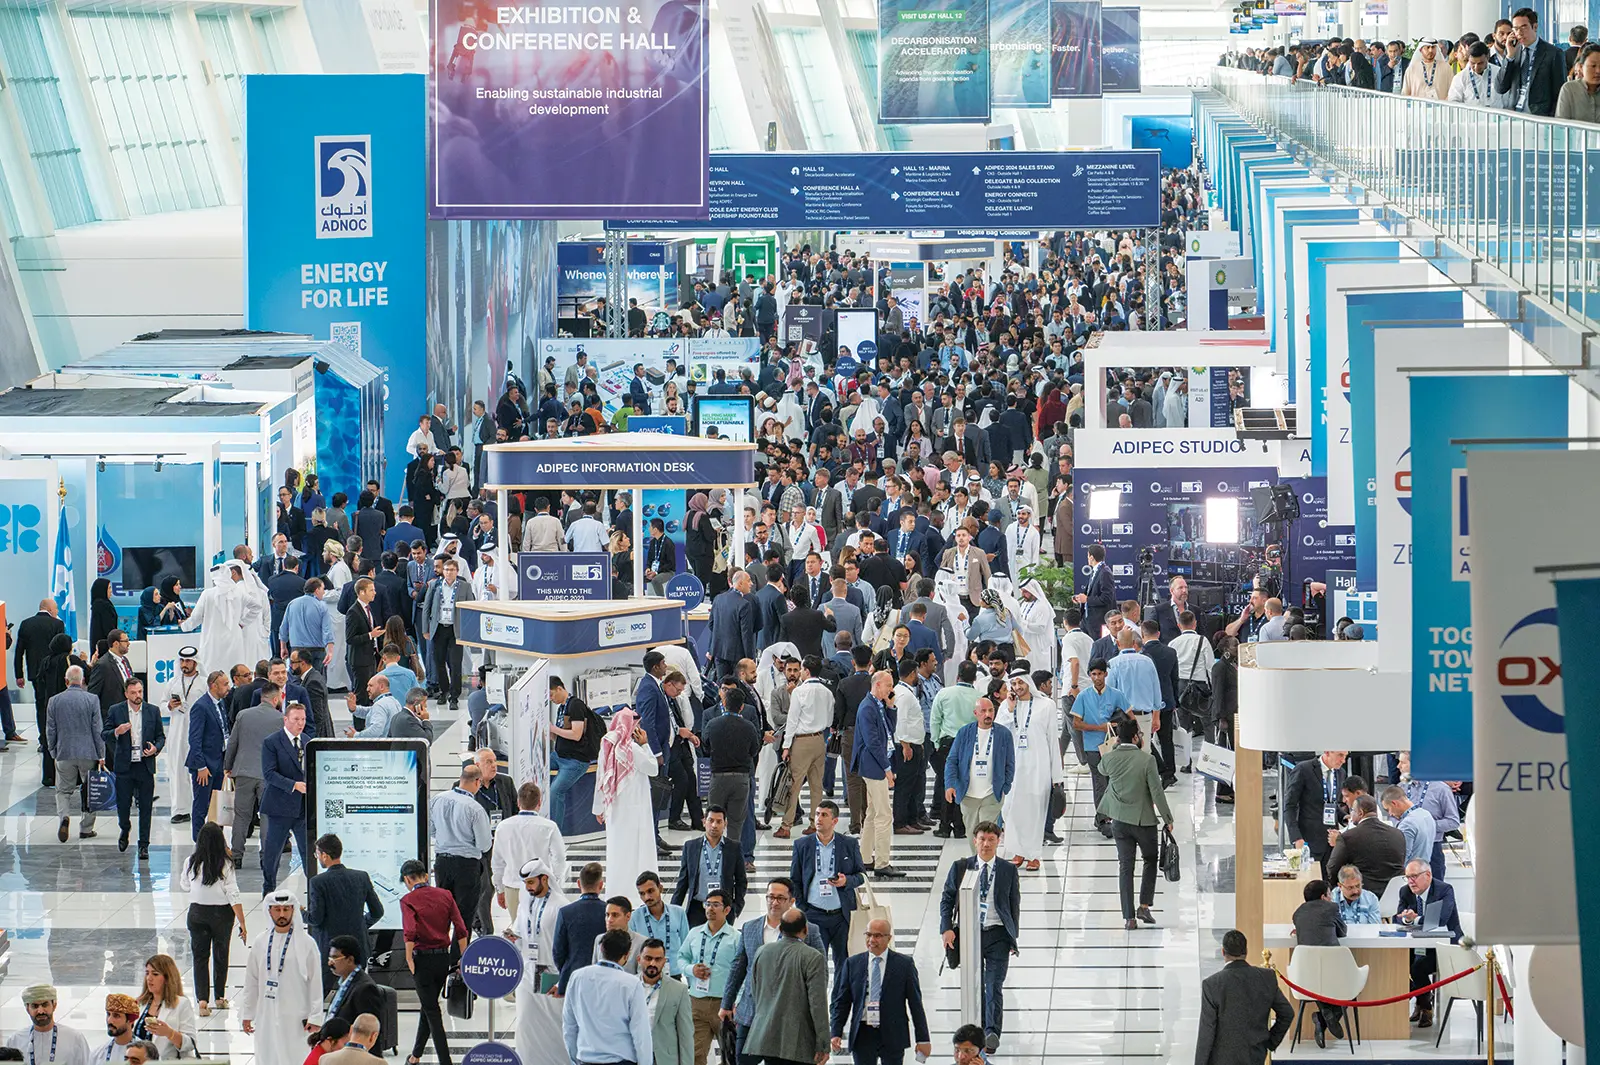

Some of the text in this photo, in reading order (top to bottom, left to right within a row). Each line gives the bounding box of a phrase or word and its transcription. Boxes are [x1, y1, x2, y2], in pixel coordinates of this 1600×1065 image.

[496, 6, 642, 24] EXHIBITION &
[462, 32, 676, 50] CONFERENCE HALL
[892, 36, 977, 45] DECARBONISATION
[901, 47, 967, 56] ACCELERATOR
[1052, 44, 1080, 52] Faster.
[476, 87, 662, 101] Enabling sustainable industrial
[529, 104, 610, 116] development
[321, 218, 367, 232] ADNOC
[300, 261, 388, 285] ENERGY
[301, 286, 388, 309] FOR LIFE
[1112, 439, 1241, 454] ADIPEC STUDIO
[536, 462, 694, 473] ADIPEC INFORMATION DESK
[506, 625, 520, 634] NPCC
[630, 622, 646, 630] NPCC
[478, 956, 504, 967] MAY I
[464, 965, 518, 978] HELP YOU?
